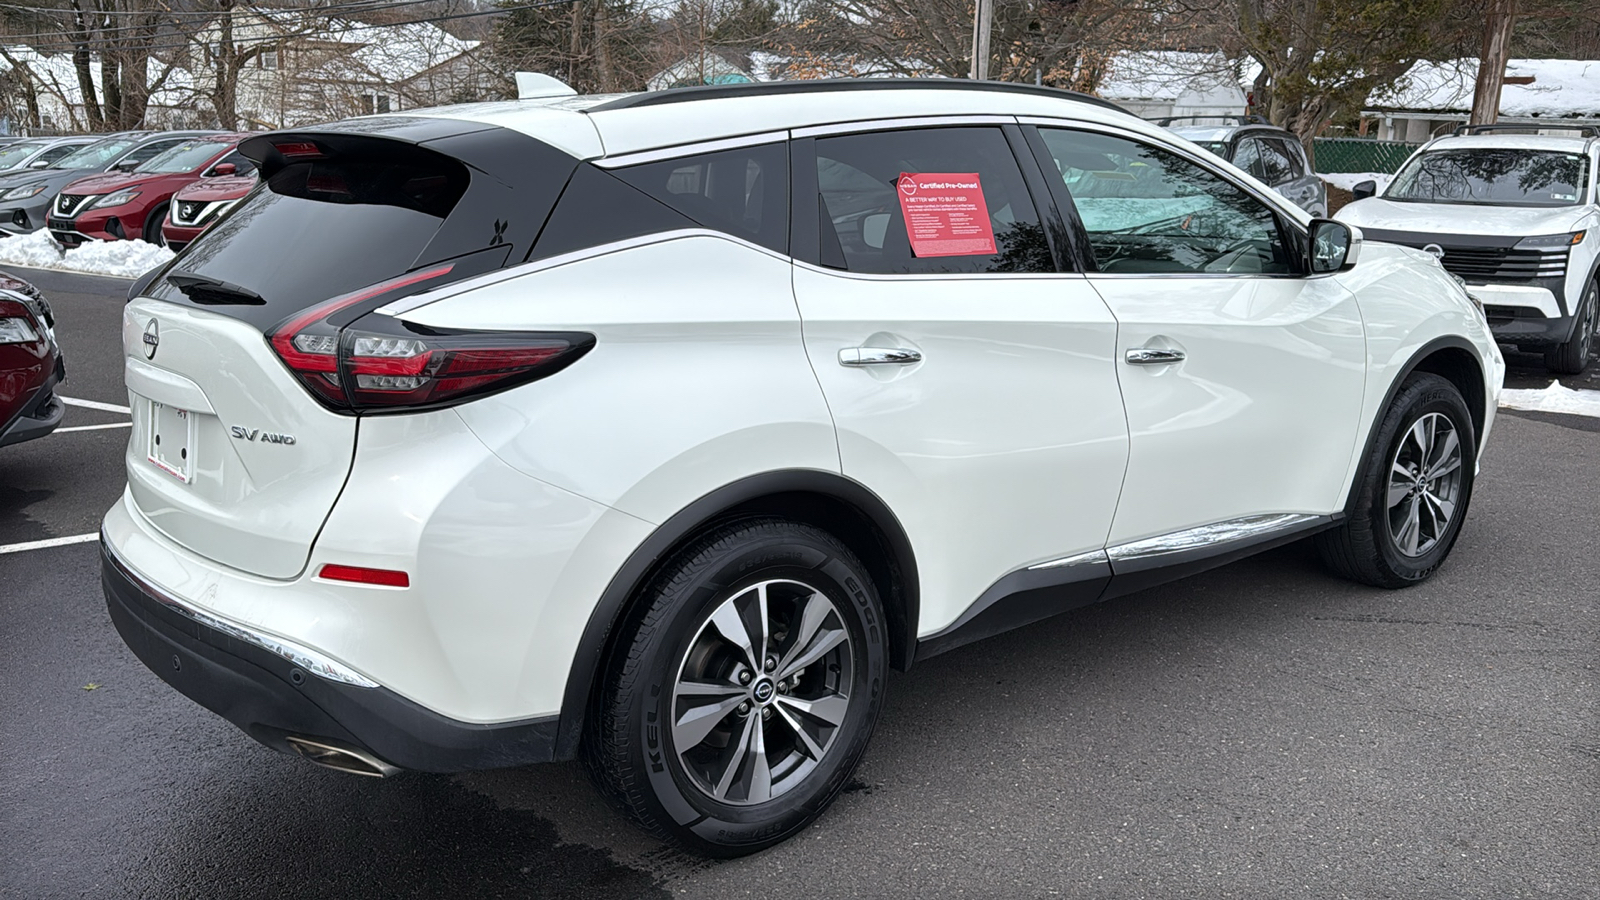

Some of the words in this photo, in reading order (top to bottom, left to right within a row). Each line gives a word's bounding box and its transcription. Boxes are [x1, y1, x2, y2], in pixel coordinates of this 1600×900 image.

[231, 425, 259, 442] SV
[261, 432, 296, 445] AWD
[646, 683, 665, 773] KELL
